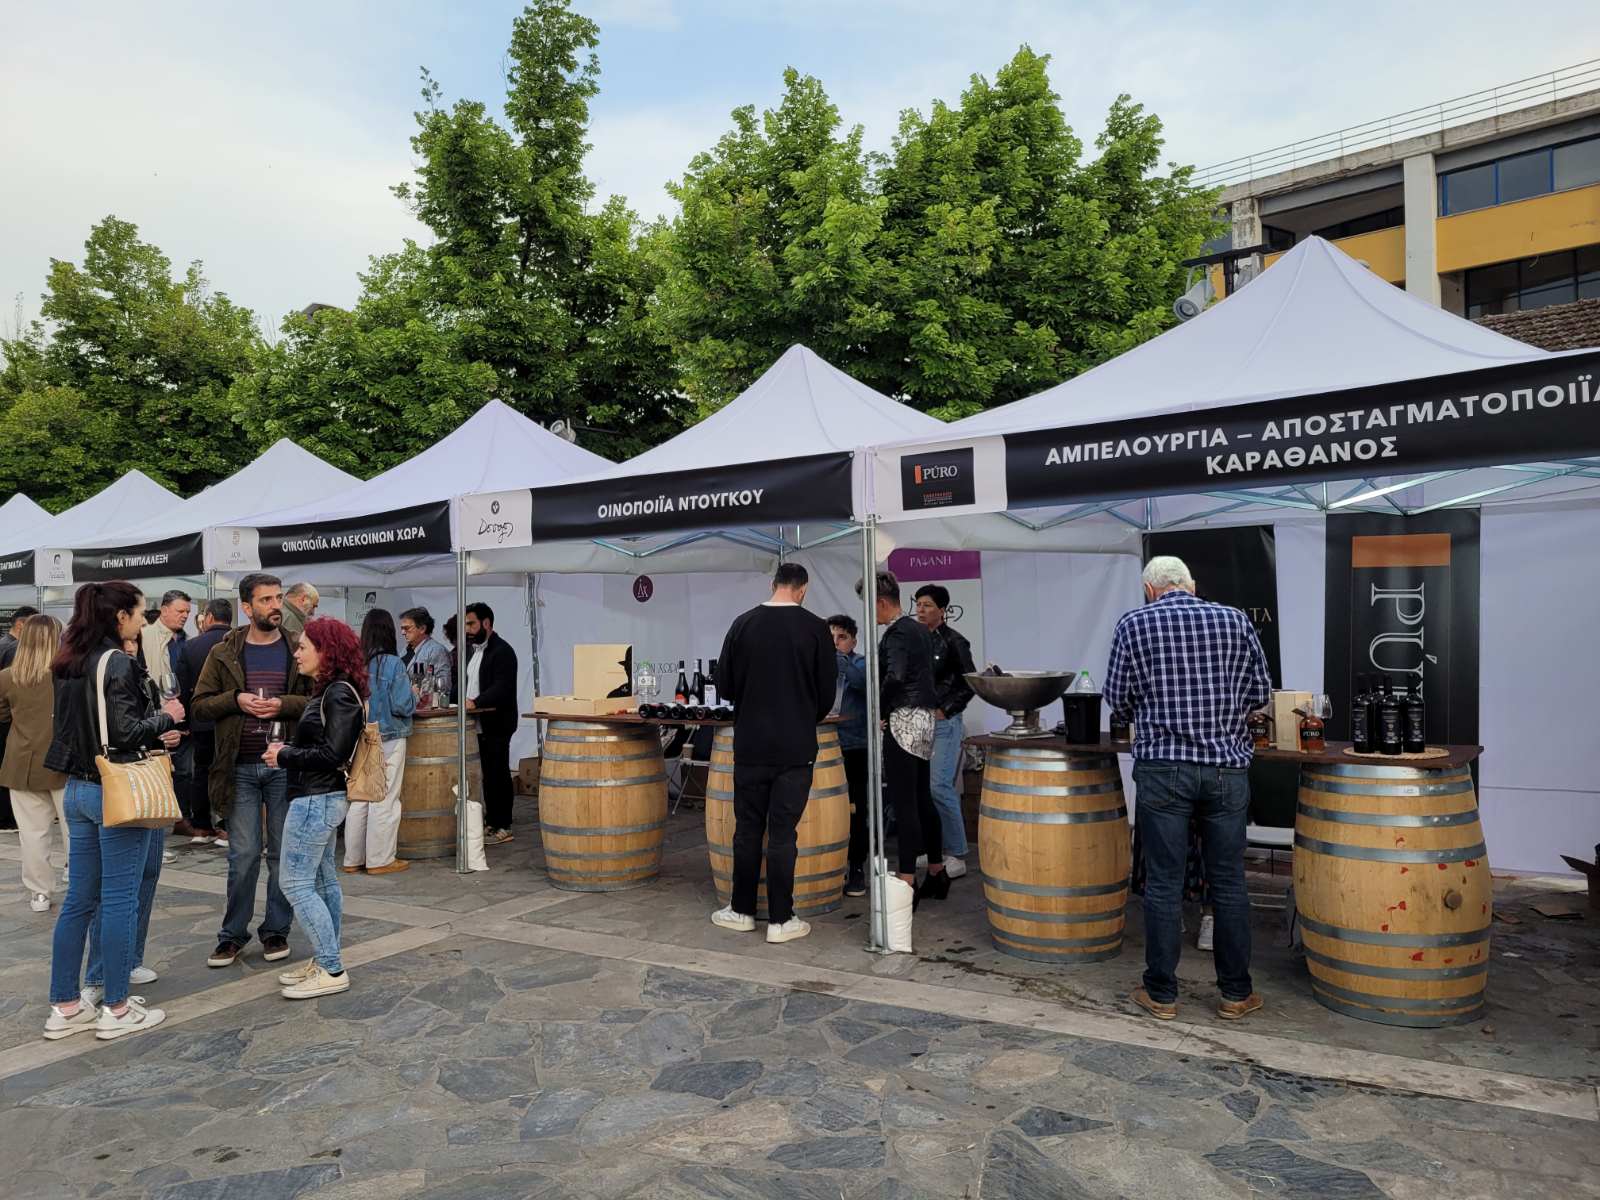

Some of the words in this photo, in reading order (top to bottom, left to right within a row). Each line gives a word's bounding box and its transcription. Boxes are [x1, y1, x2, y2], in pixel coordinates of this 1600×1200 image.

[1045, 428, 1229, 466] ΑΜΠΕΛΟΥΡΓΙΑ
[1206, 436, 1398, 475] ΚΑΡΑΘΑΝΟΣ
[597, 495, 674, 519] ΟΙΝΟΠΟΙΪΑ
[678, 488, 764, 511] ΝΤΟΥΓΚΟΥ
[282, 536, 329, 553] ΟΙΝΟΠΟΙΪΑ
[330, 530, 394, 549] ΑΡΛΕΚΟΙΝΩΝ
[397, 526, 426, 541] ΧΩΡΑ
[101, 558, 124, 569] ΚΤΗΜΑ
